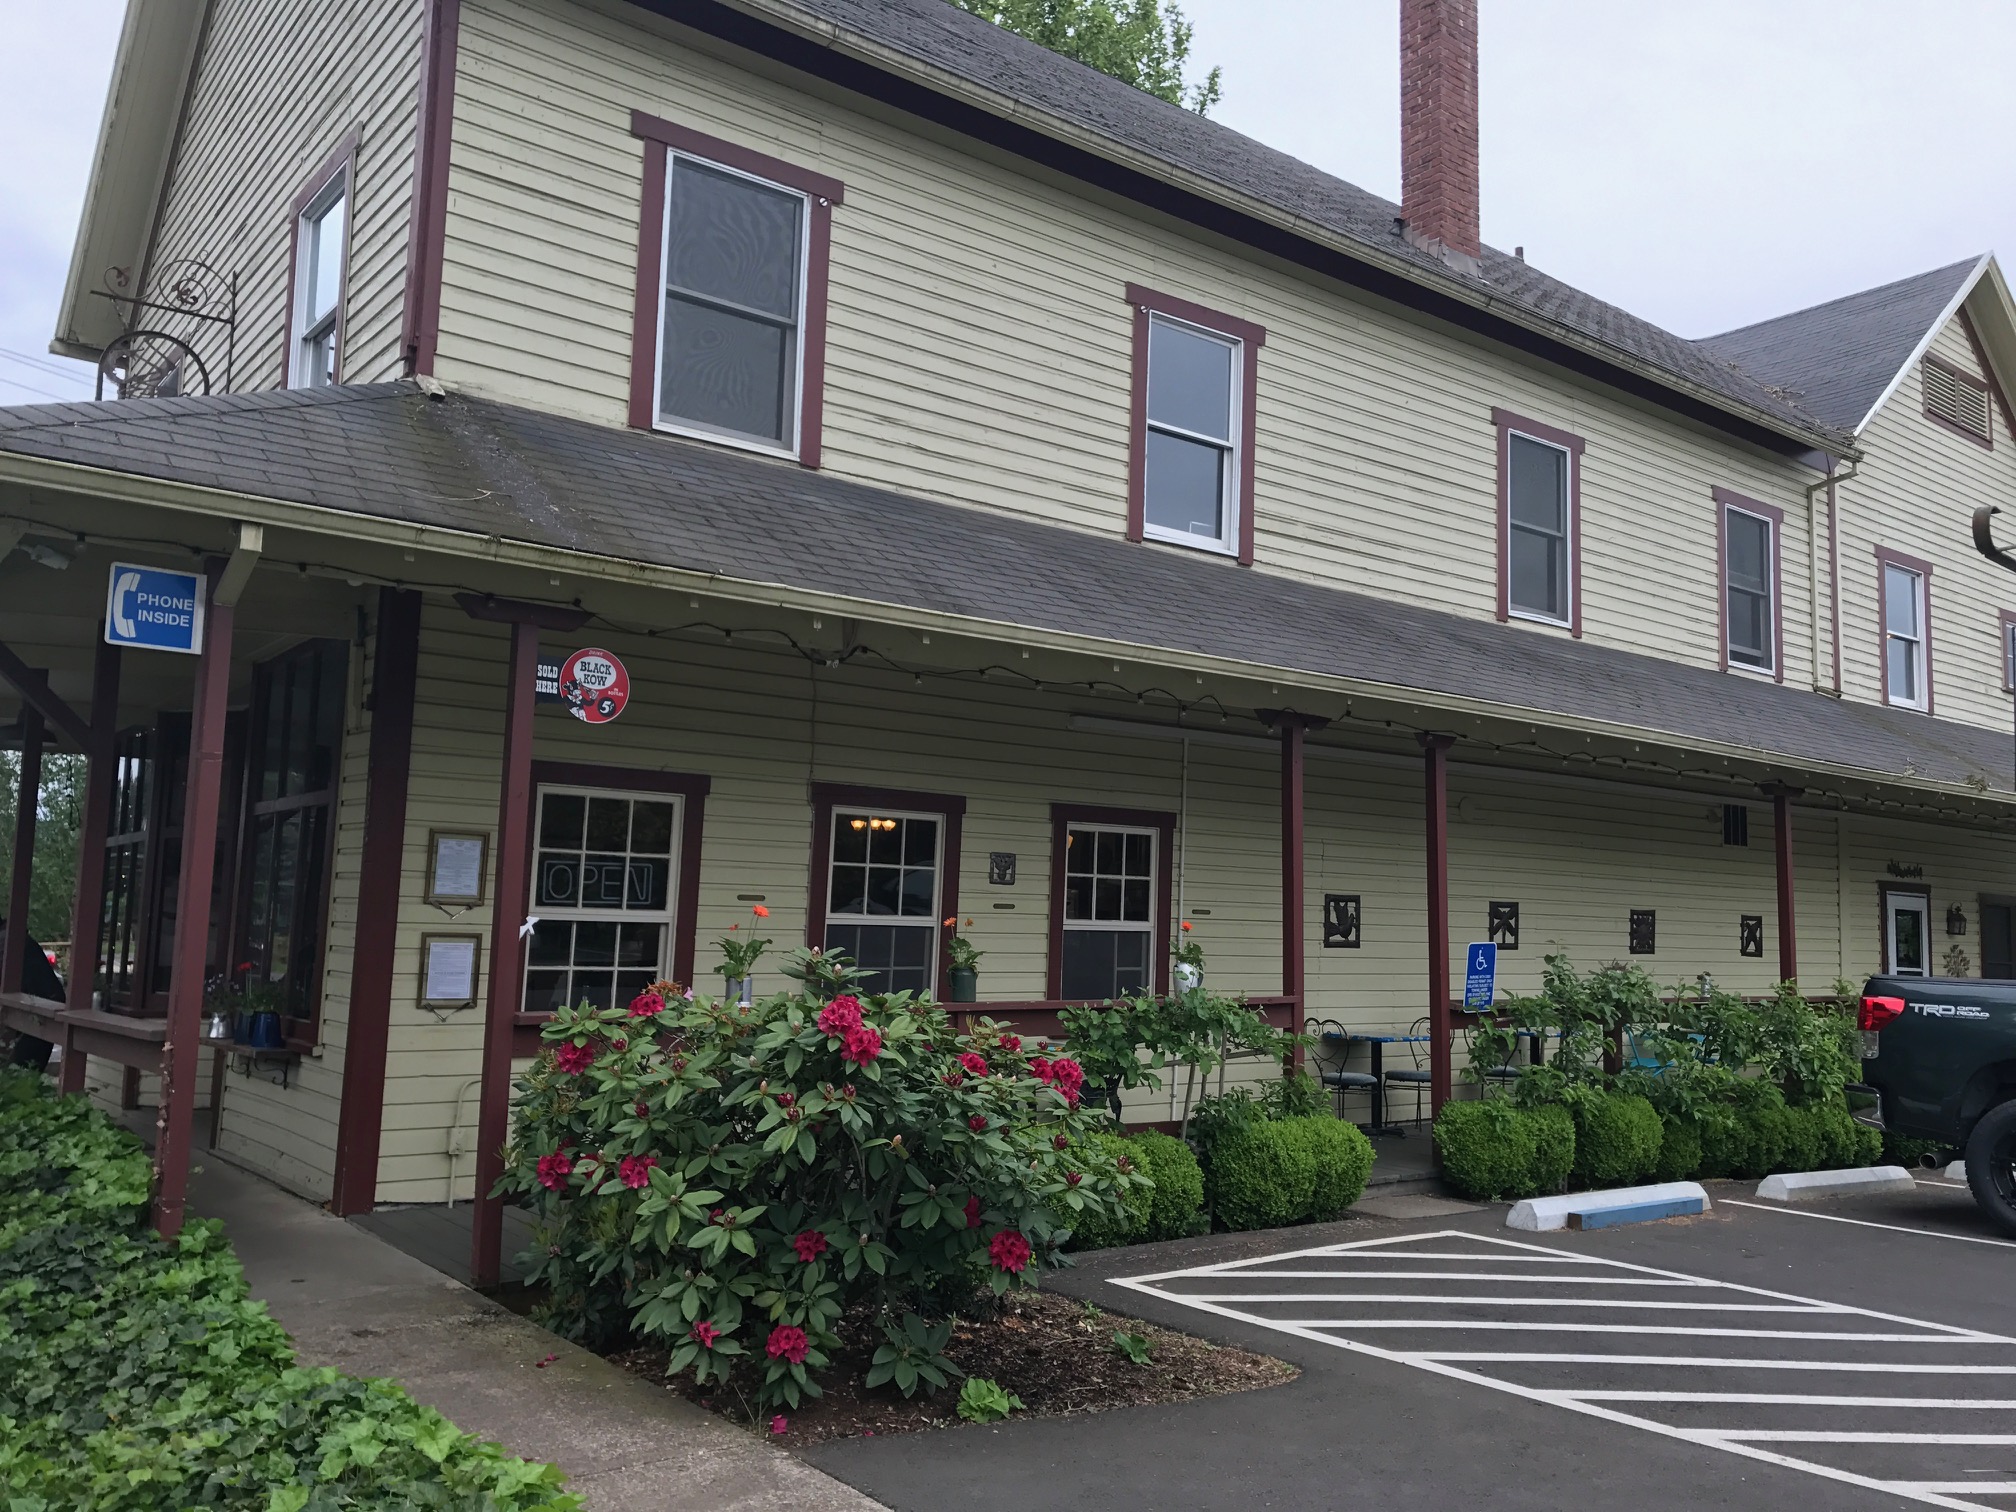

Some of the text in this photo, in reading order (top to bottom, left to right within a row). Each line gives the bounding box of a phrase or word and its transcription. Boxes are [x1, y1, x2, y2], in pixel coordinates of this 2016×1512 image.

[137, 592, 194, 611] PHONE
[137, 609, 190, 627] INSIDE
[537, 664, 558, 679] SOLD
[580, 661, 612, 675] BLACK
[535, 679, 558, 695] HERE
[583, 673, 608, 687] KOW
[548, 864, 649, 901] OPEN
[1908, 1002, 1956, 1018] TRD
